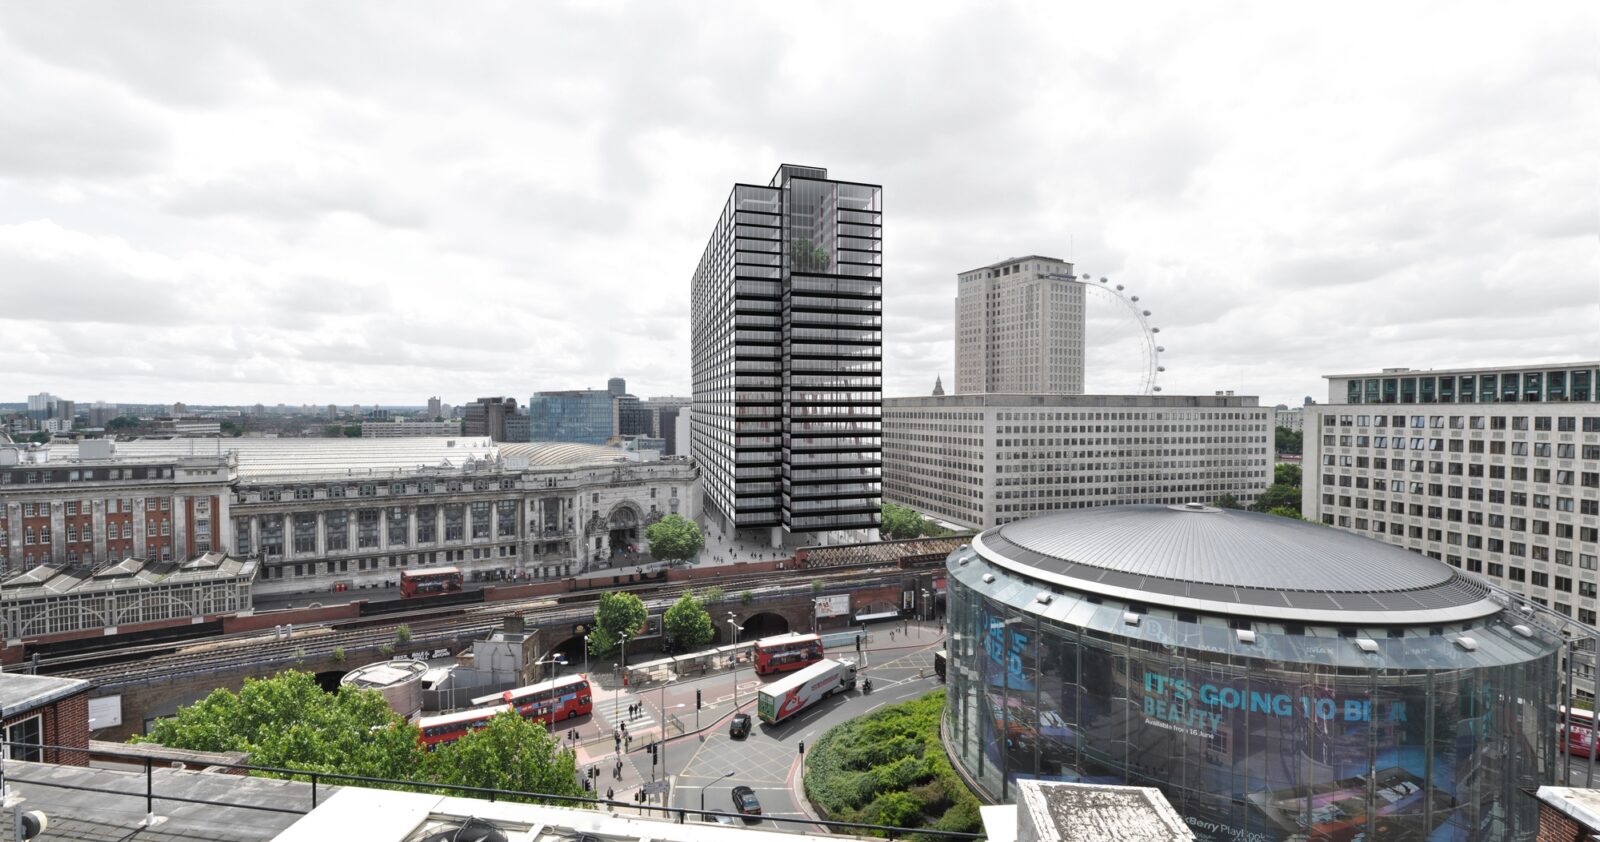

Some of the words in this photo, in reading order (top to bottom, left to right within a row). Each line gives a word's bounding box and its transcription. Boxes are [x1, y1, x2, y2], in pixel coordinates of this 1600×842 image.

[1144, 671, 1193, 700] IT'S
[1200, 683, 1293, 717] GOING
[1144, 695, 1222, 734] BEAUTY
[1173, 725, 1188, 734] fro
